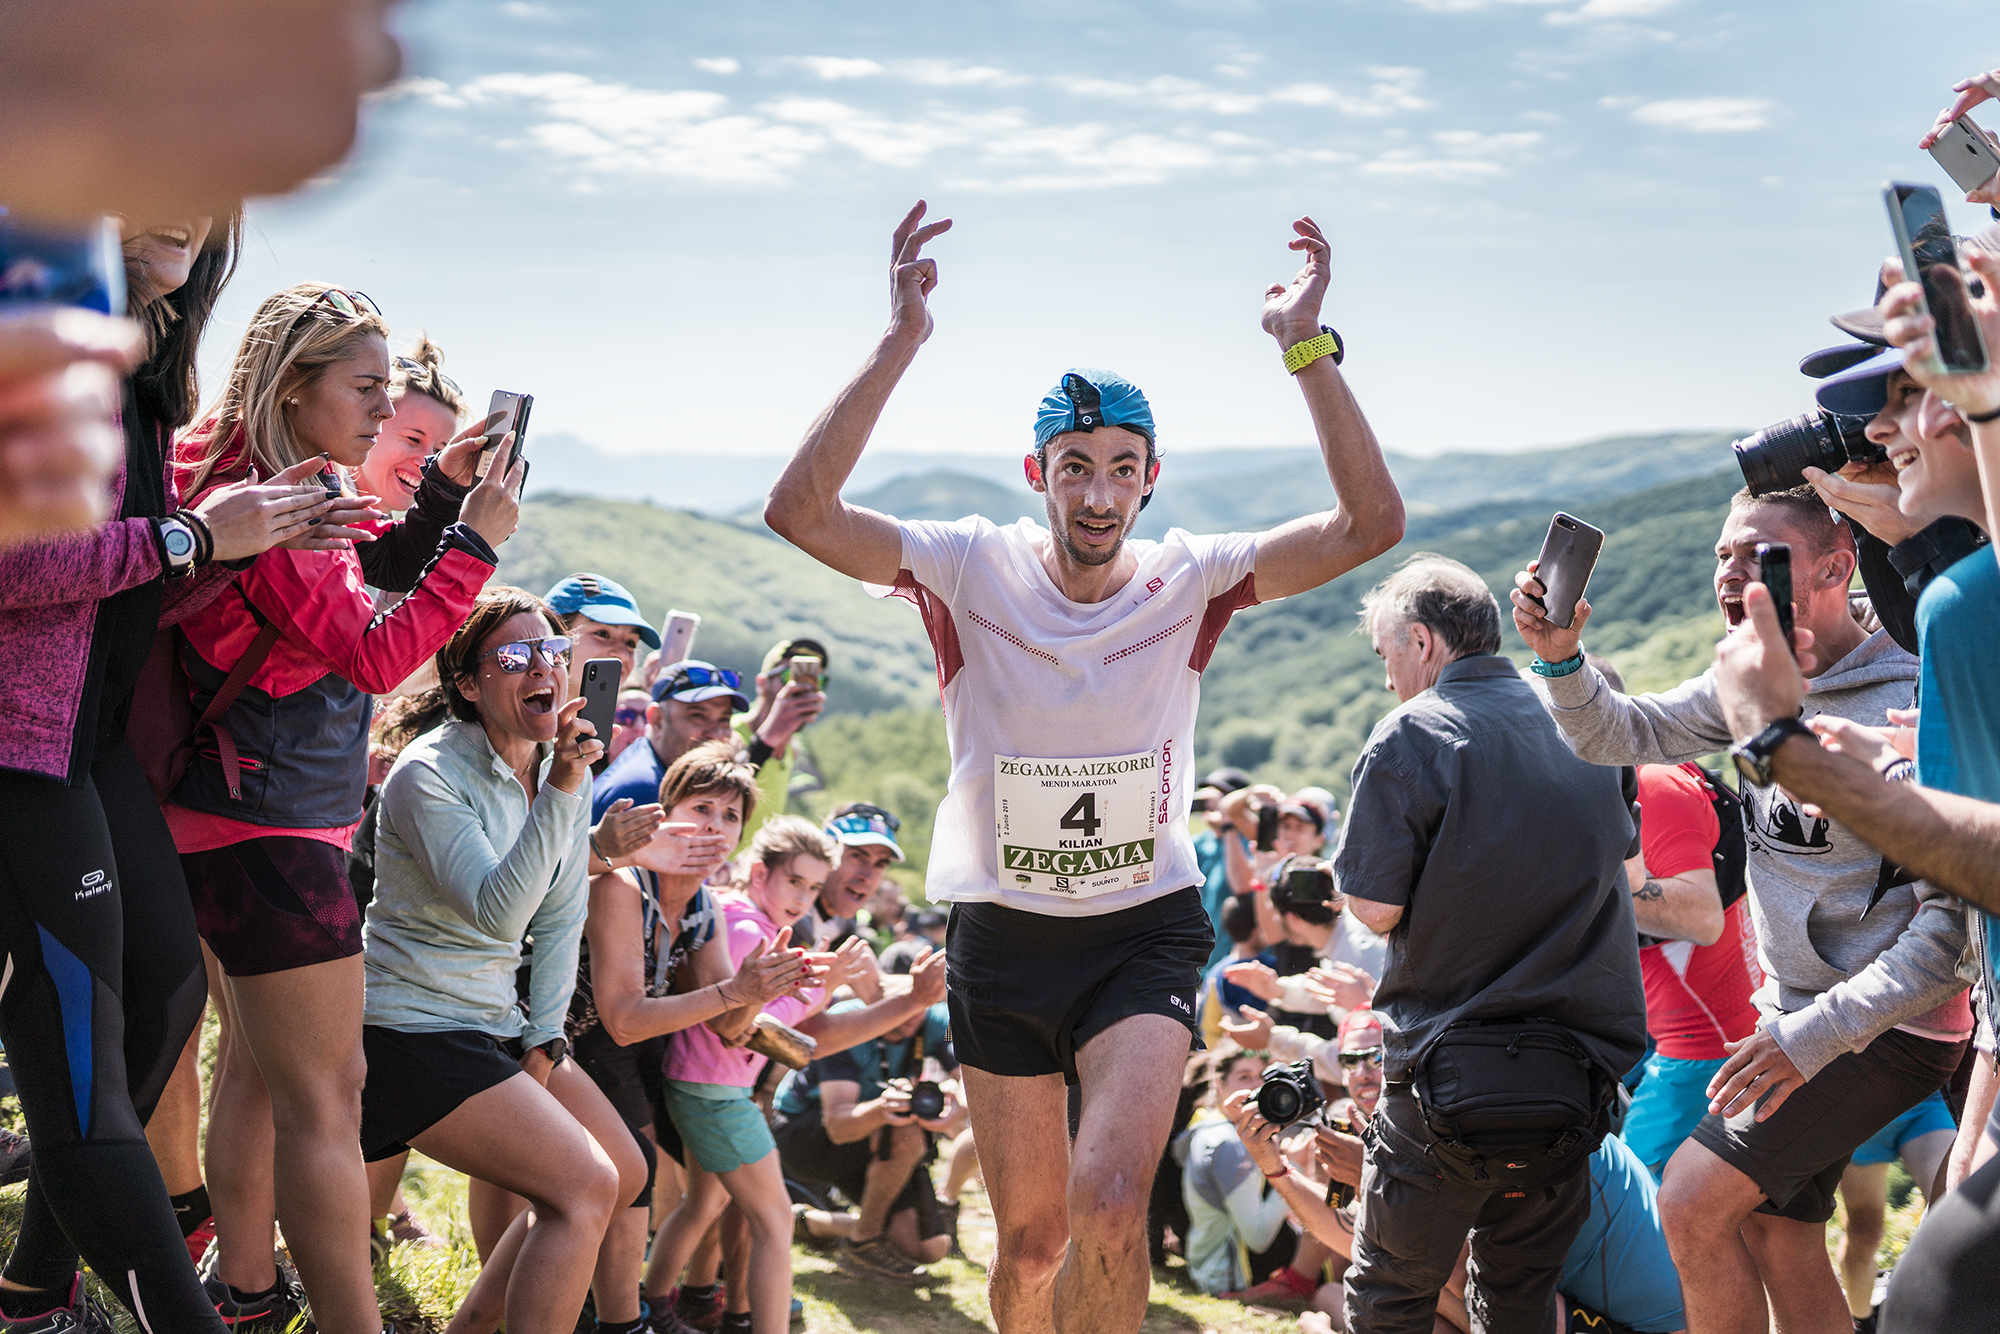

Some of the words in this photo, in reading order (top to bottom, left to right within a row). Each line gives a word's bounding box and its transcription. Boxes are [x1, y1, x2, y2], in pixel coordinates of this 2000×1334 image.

[1000, 756, 1155, 776] ZEGAMA-AIZKORRI
[1041, 780, 1070, 788] MENDI
[1072, 778, 1117, 787] MARATOIA
[1158, 739, 1173, 824] salomon
[1060, 792, 1101, 836] 4
[1059, 838, 1102, 848] KILIAN
[1010, 842, 1148, 874] ZEGAMA
[1091, 876, 1120, 887] SUUNTO
